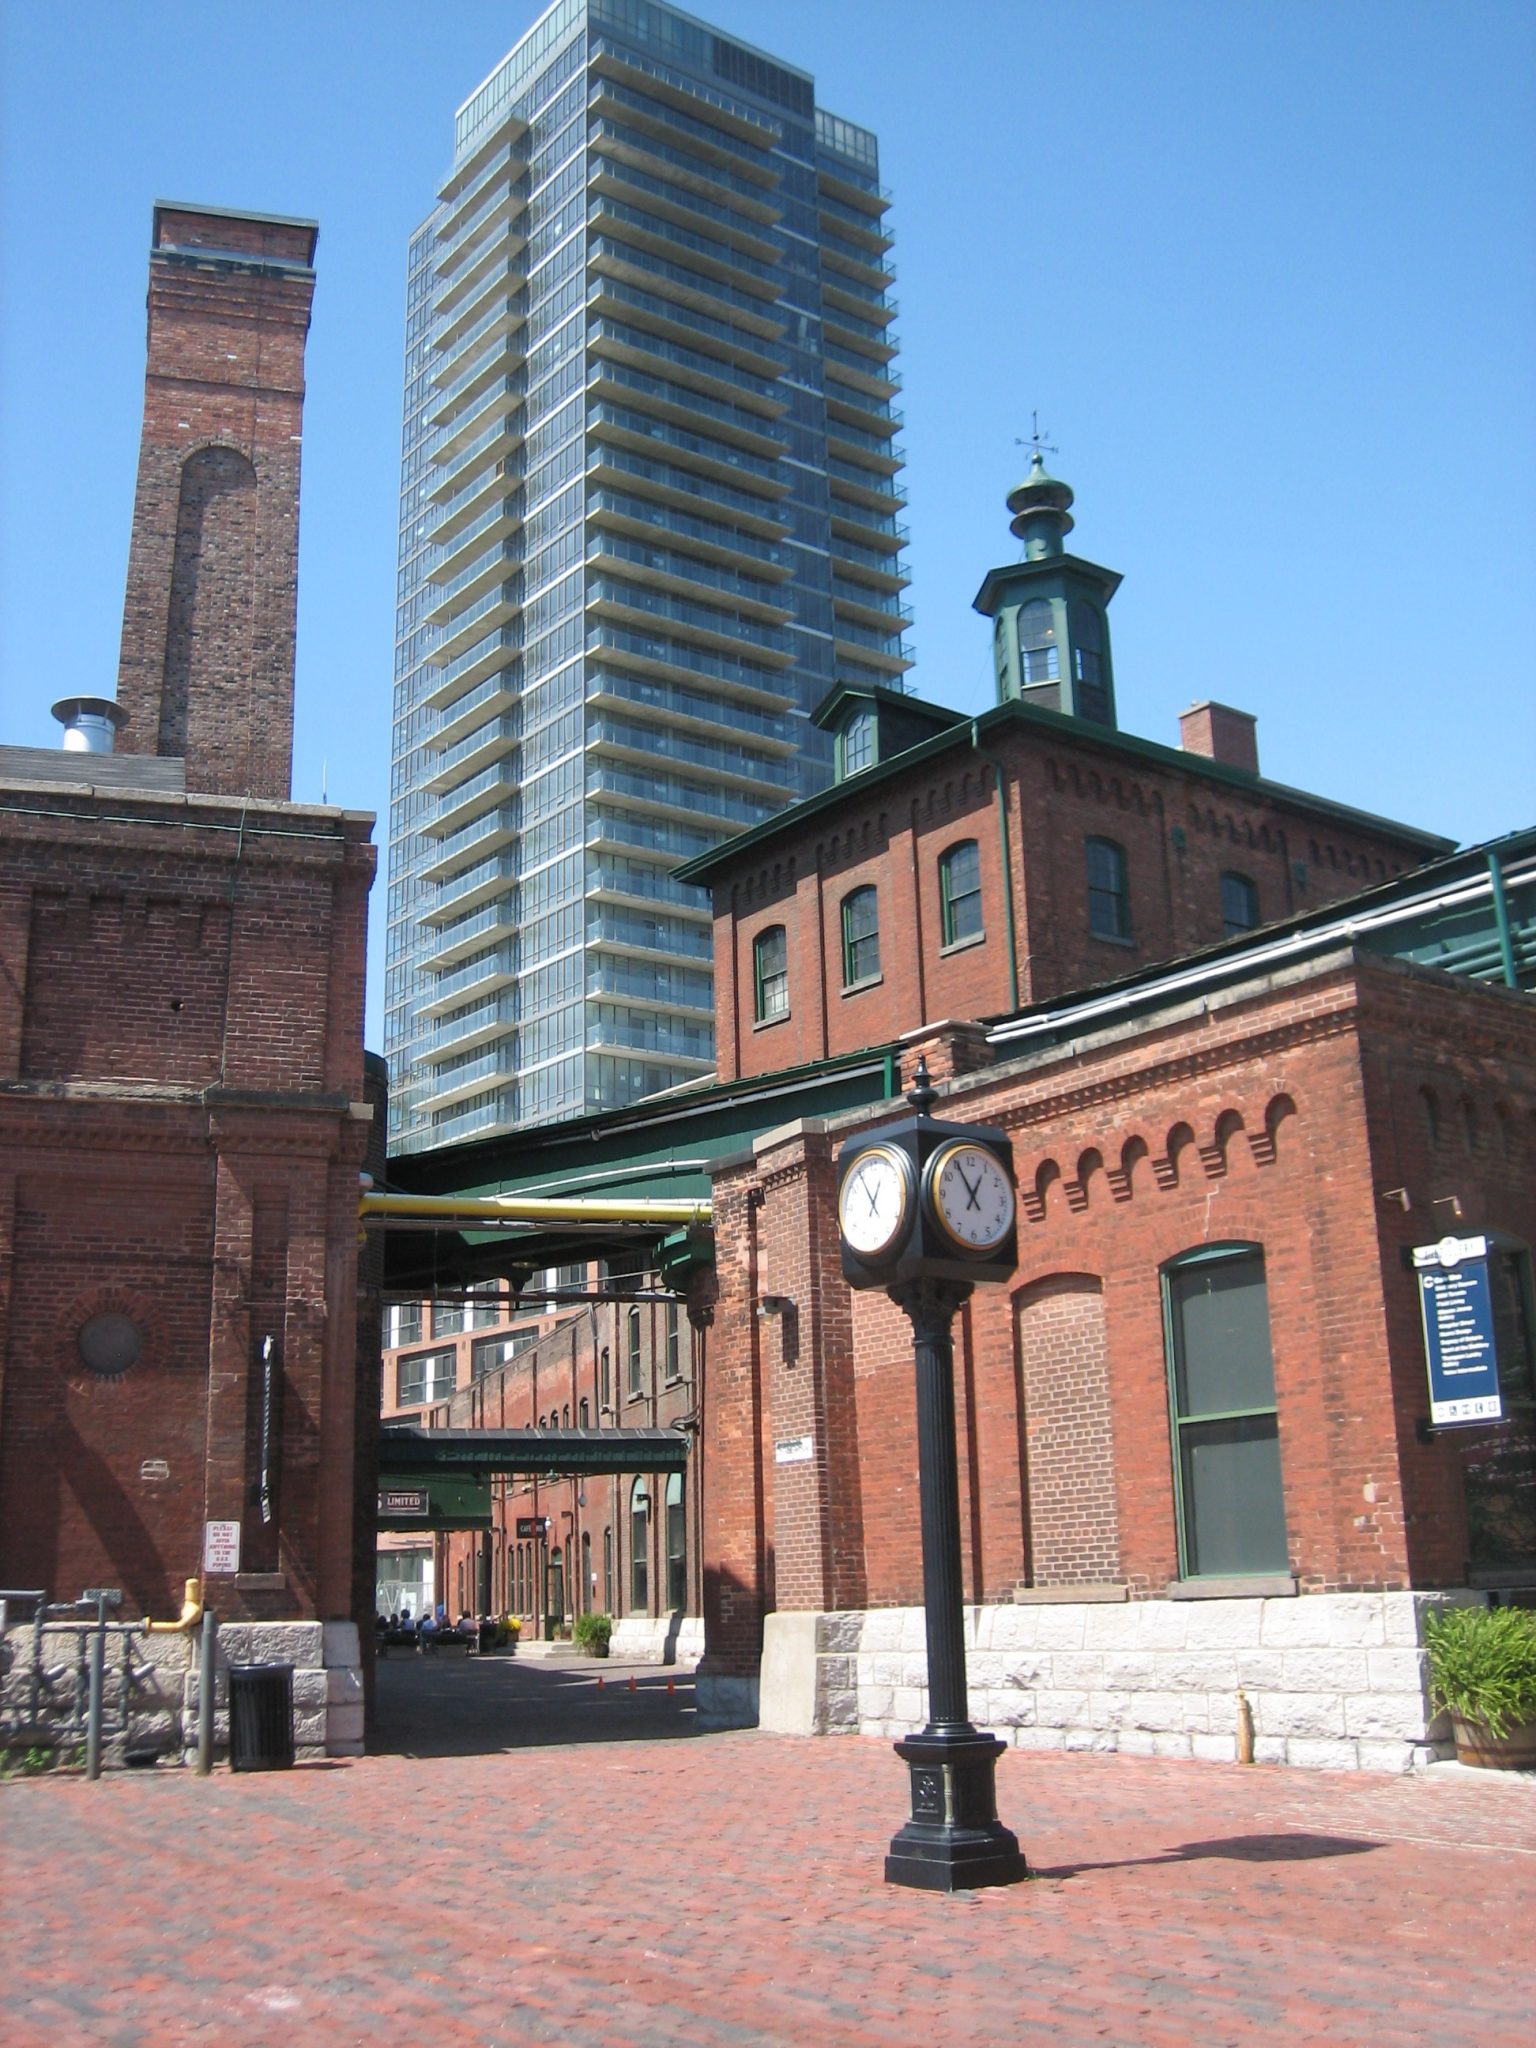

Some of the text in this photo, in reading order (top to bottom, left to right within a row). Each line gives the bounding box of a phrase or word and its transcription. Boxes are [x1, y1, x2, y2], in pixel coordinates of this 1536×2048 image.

[965, 1155, 976, 1168] 12
[944, 1171, 954, 1182] 10
[387, 1496, 421, 1506] LIMITED
